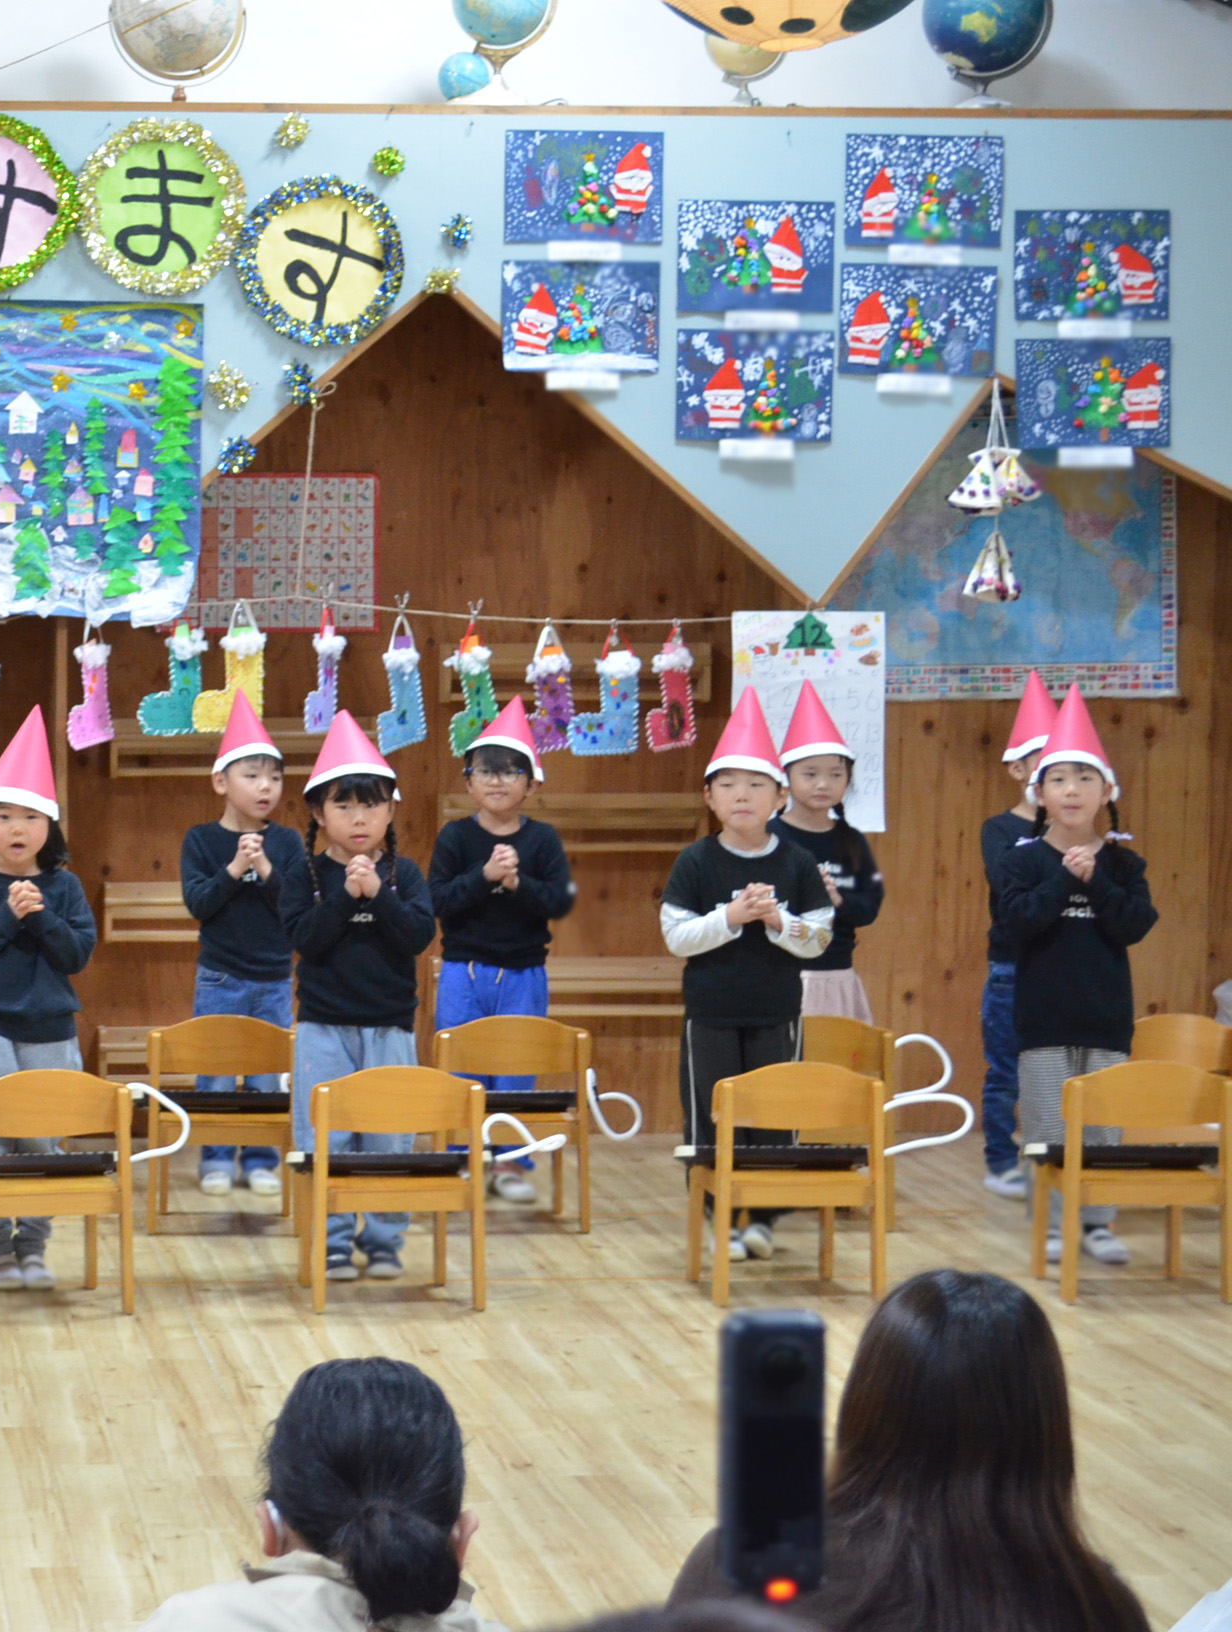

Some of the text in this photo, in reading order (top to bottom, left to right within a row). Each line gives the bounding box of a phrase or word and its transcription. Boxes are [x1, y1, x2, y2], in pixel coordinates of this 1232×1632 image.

[796, 622, 826, 647] 12
[847, 687, 861, 711] 5
[866, 689, 882, 712] 6
